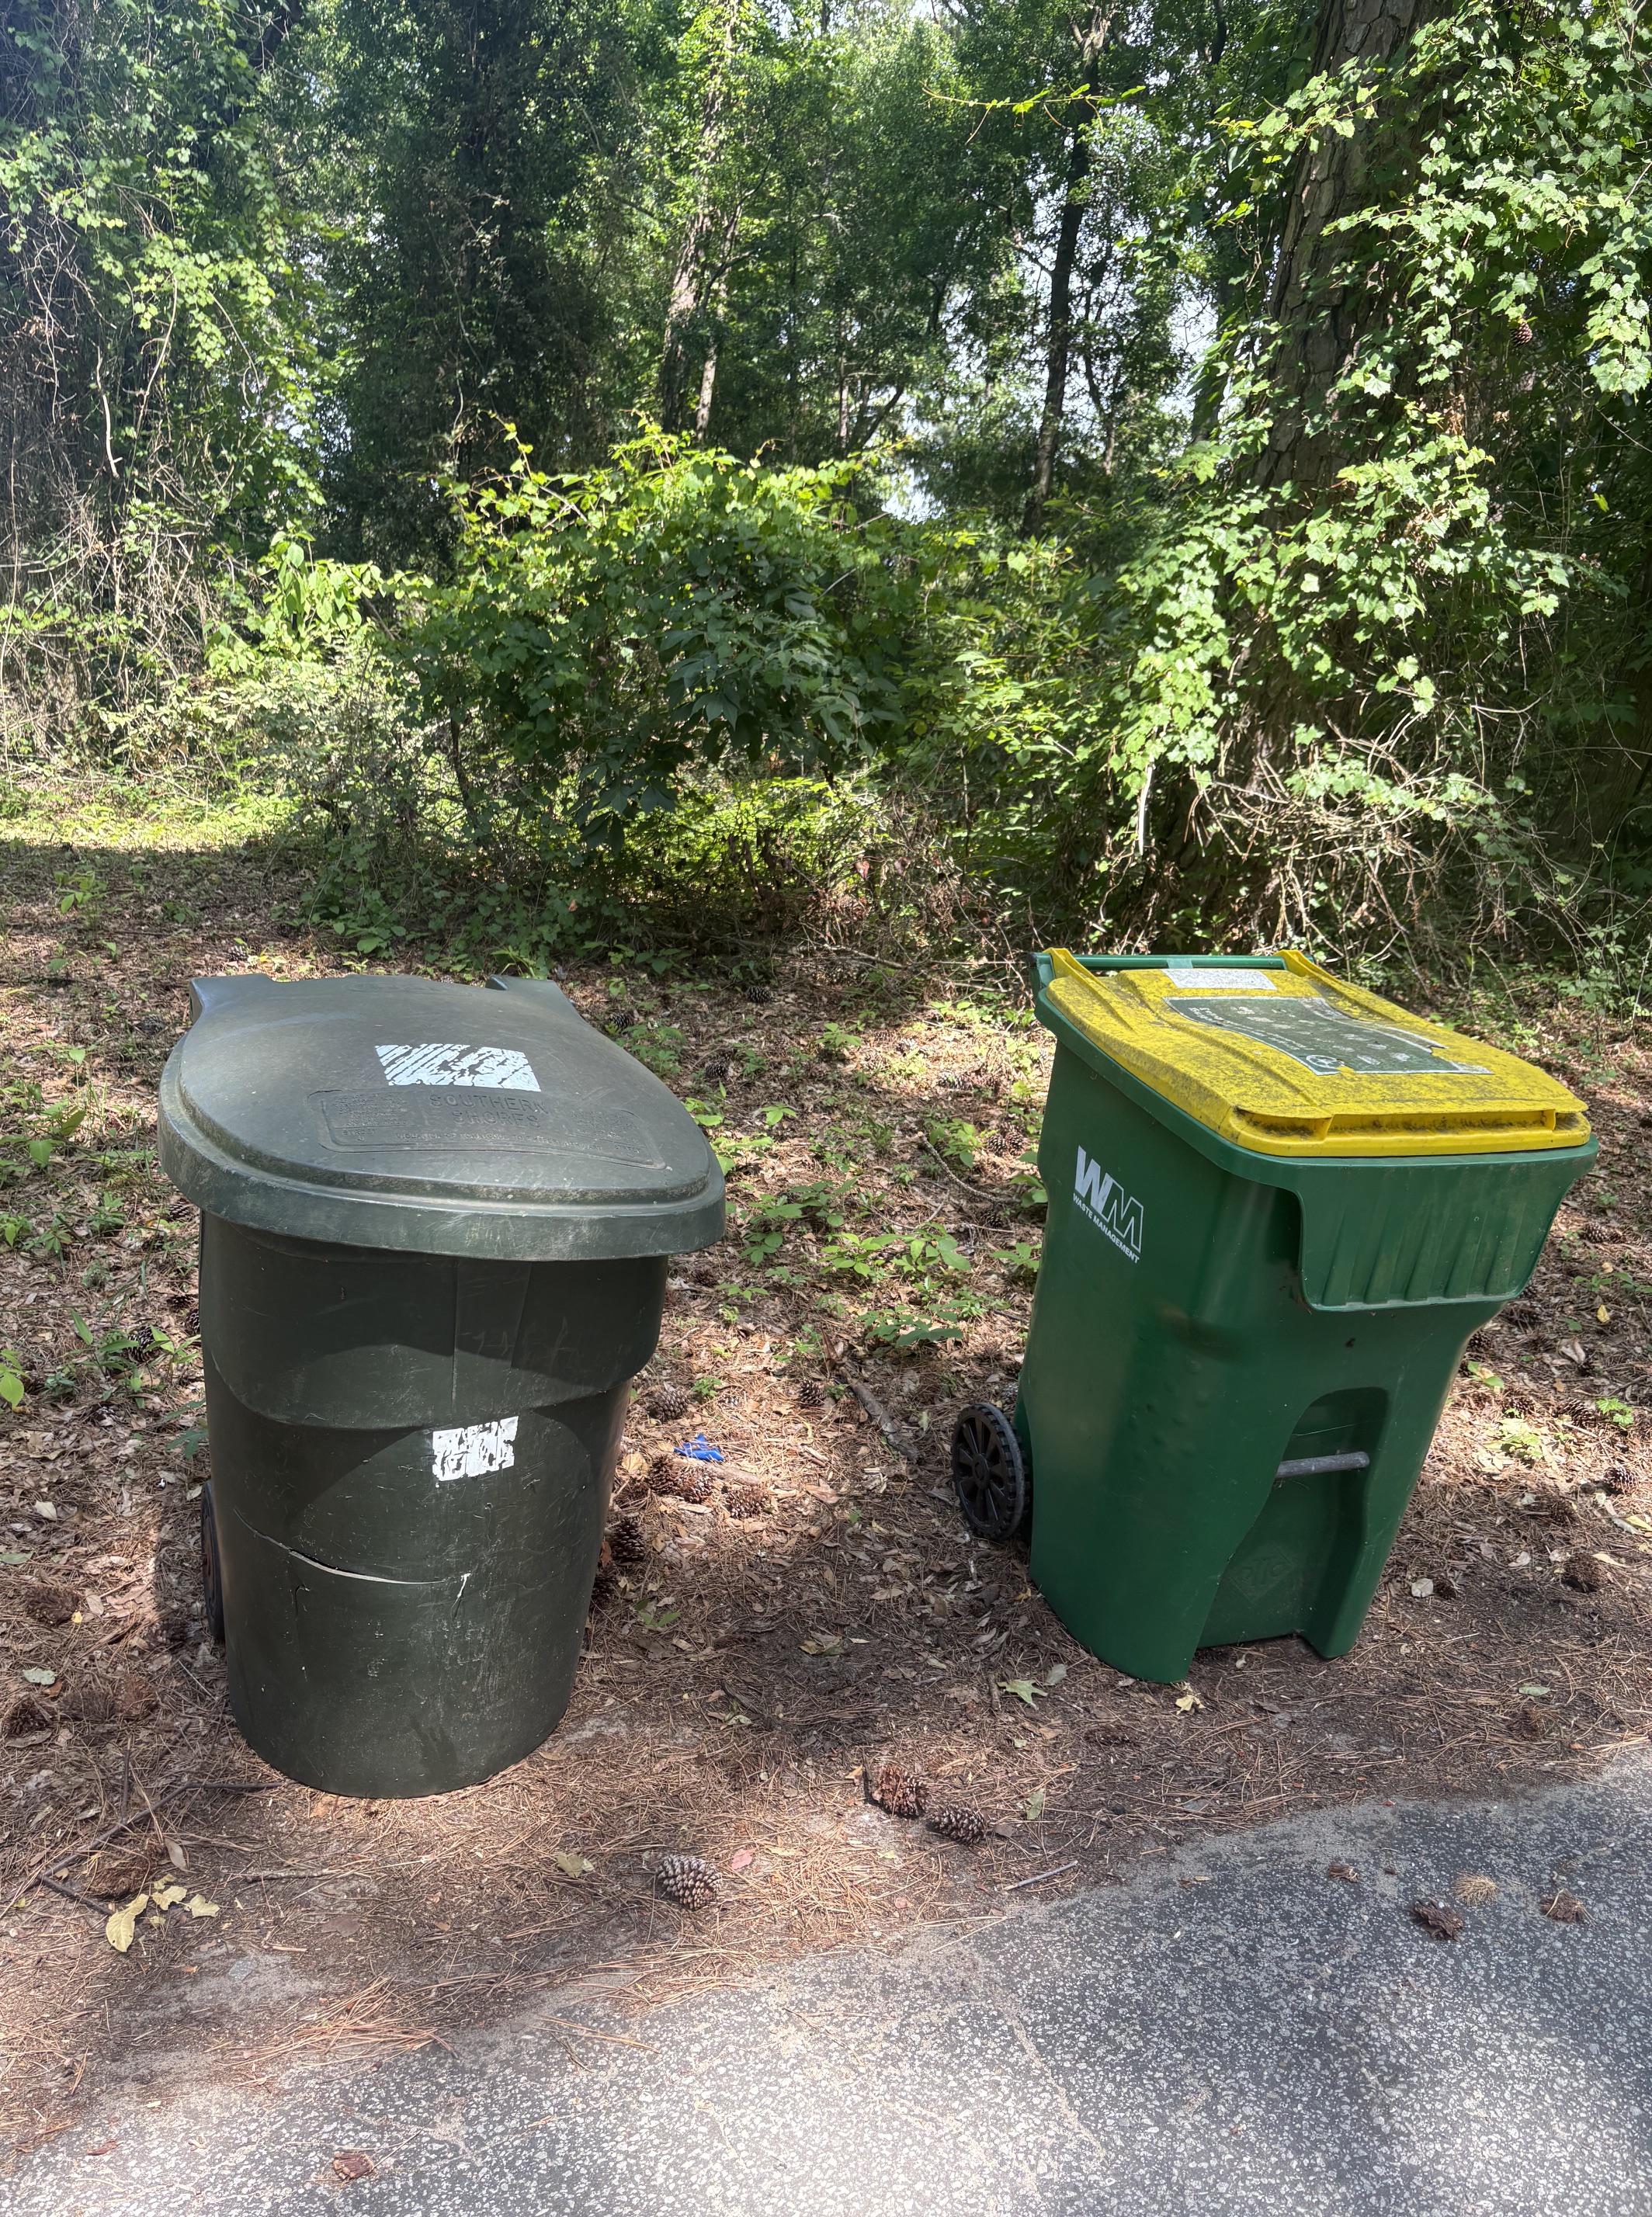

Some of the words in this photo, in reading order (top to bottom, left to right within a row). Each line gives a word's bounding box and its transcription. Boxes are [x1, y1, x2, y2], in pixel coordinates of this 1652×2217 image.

[429, 1093, 550, 1115] SOUTHERN
[451, 1110, 541, 1129] SHORES
[1074, 1145, 1144, 1254] WM
[1073, 1192, 1093, 1219] WASTE
[1092, 1215, 1140, 1264] MANAGEMENT
